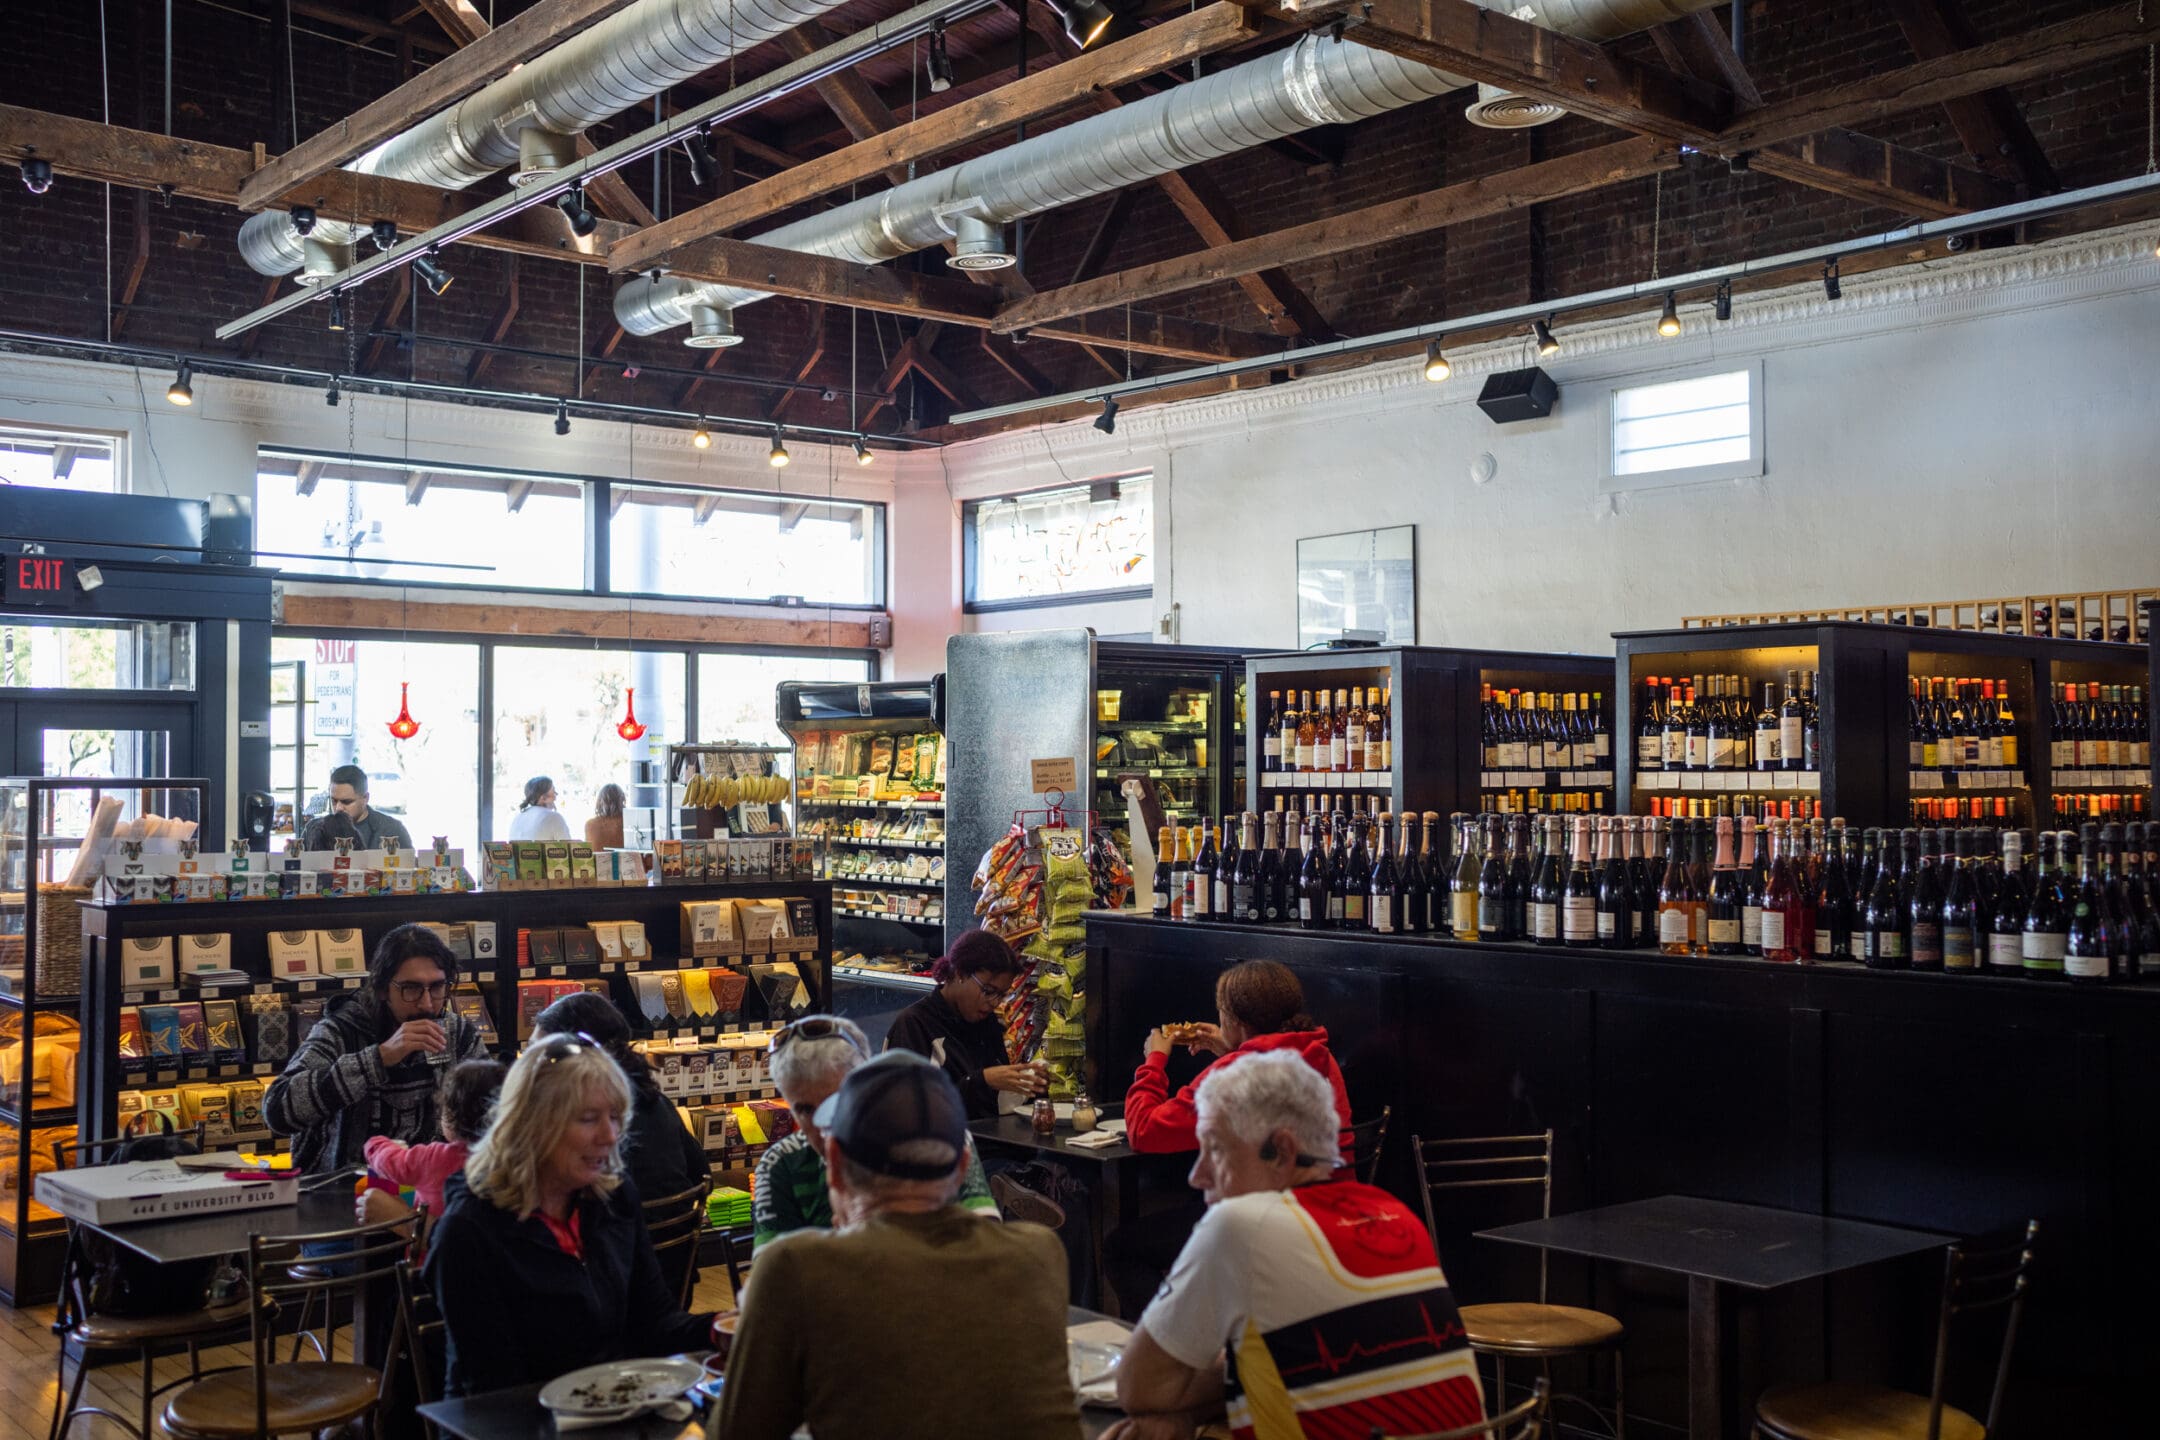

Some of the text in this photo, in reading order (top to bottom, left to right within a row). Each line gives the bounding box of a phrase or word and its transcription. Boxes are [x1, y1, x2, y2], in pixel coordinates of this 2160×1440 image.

[19, 558, 64, 591] EXIT
[317, 638, 354, 663] STOP
[329, 669, 340, 681] FOR
[317, 685, 352, 697] PEDESTRIANS
[331, 702, 337, 712] IN
[318, 717, 350, 728] CROSSWALK
[133, 1191, 275, 1215] 444 E UNIVERSITY BLVD
